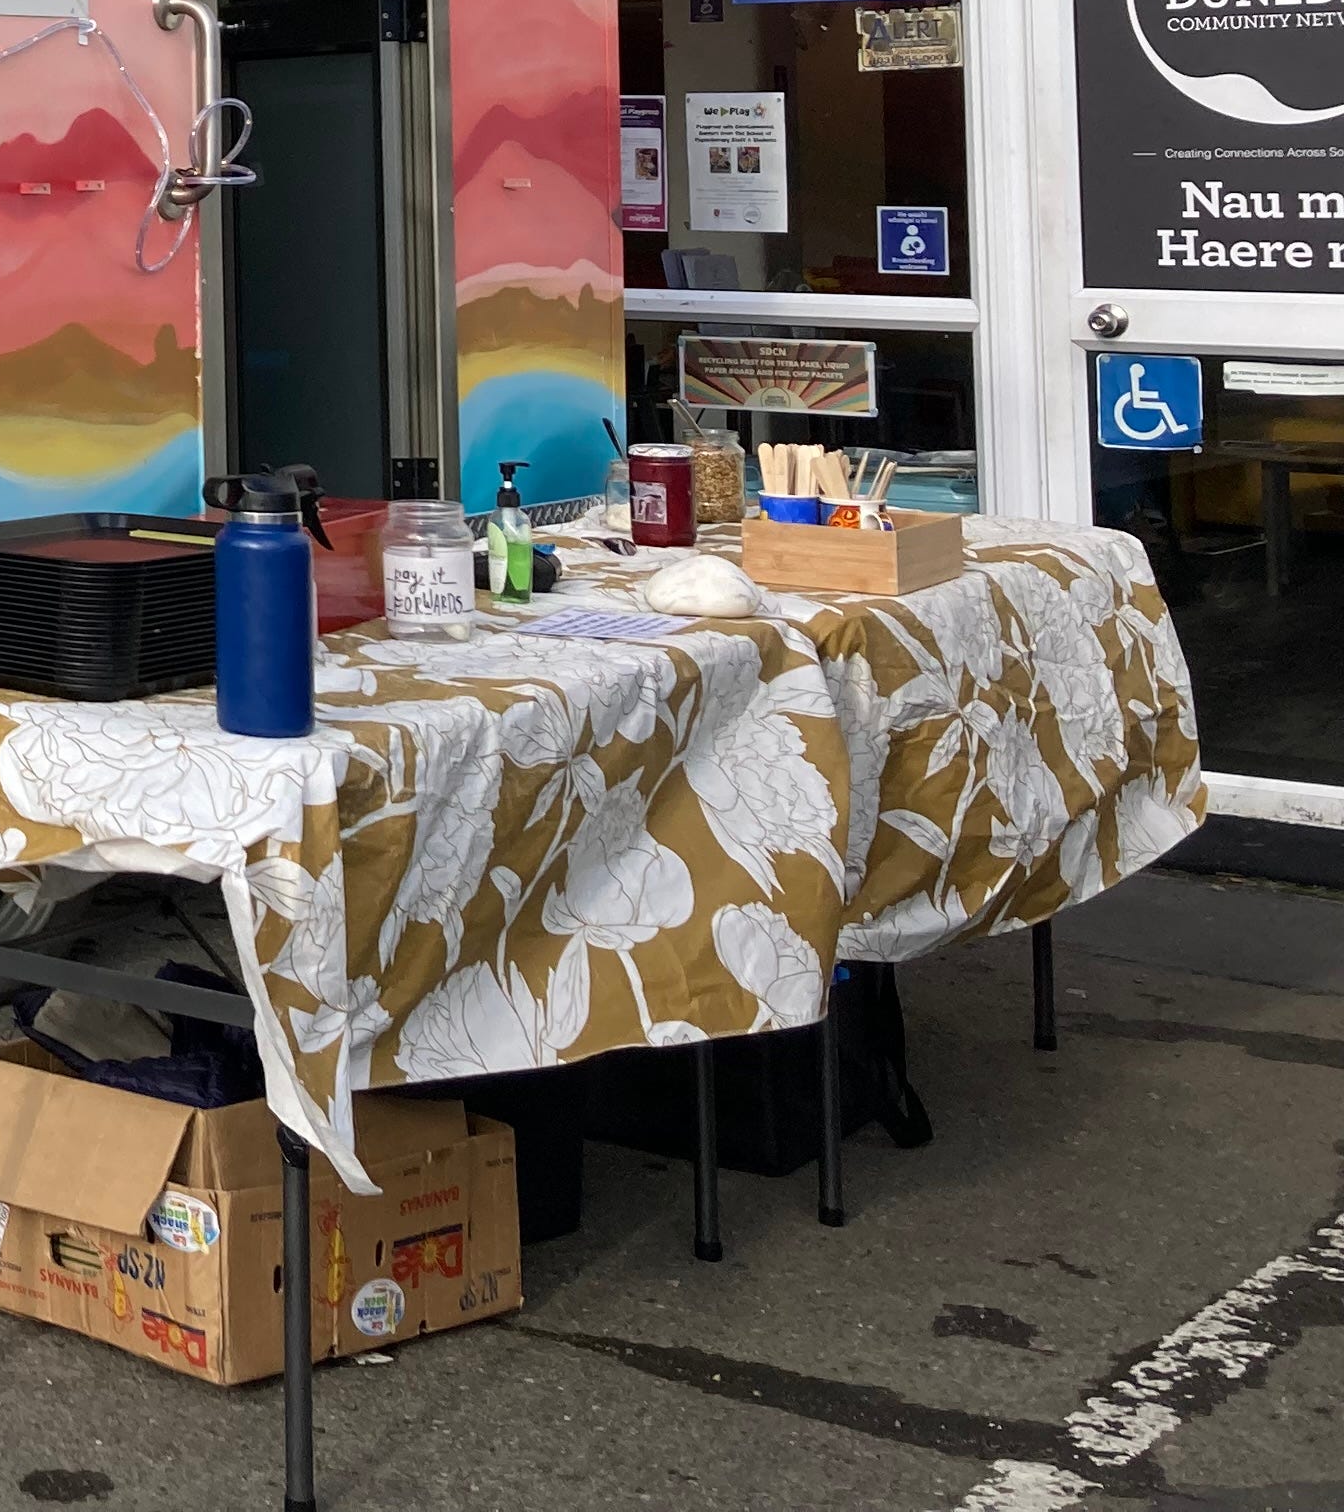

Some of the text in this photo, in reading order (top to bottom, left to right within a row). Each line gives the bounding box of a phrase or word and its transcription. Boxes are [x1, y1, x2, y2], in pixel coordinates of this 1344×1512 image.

[1167, 13, 1291, 32] COMMUNITY
[703, 107, 750, 117] We Play
[1165, 147, 1326, 161] Creating Connections Across
[1180, 181, 1284, 219] Nau
[1156, 229, 1313, 269] Haere
[759, 347, 787, 357] SDCN
[393, 568, 422, 594] pay
[400, 1186, 460, 1216] BANANAS
[392, 1233, 463, 1289] Dole
[39, 1268, 99, 1299] BANANAS
[141, 1313, 207, 1369] Dole
